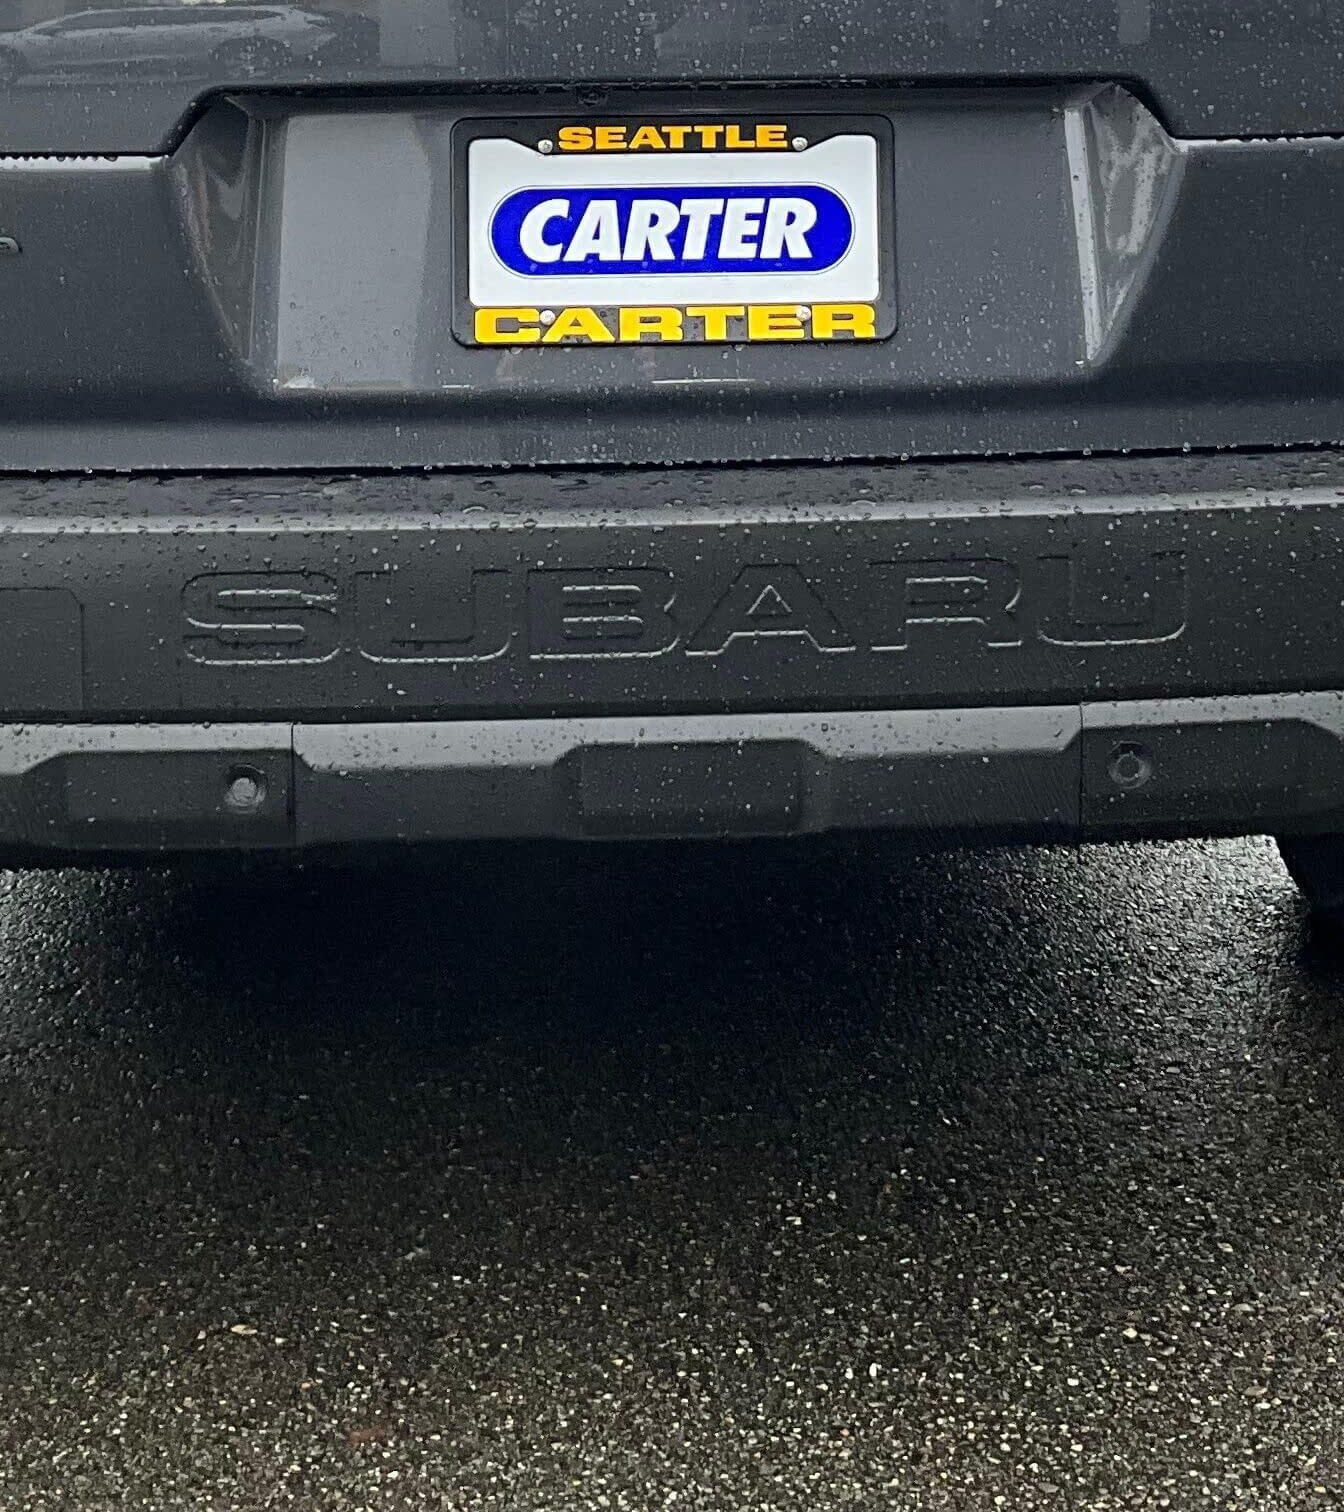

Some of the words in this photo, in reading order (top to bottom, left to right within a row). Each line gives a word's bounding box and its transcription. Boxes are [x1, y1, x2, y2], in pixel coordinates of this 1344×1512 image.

[558, 124, 788, 152] SEATTLE
[518, 196, 819, 264] CARTER
[473, 303, 877, 344] CARTER
[179, 550, 1188, 665] SUBARU
